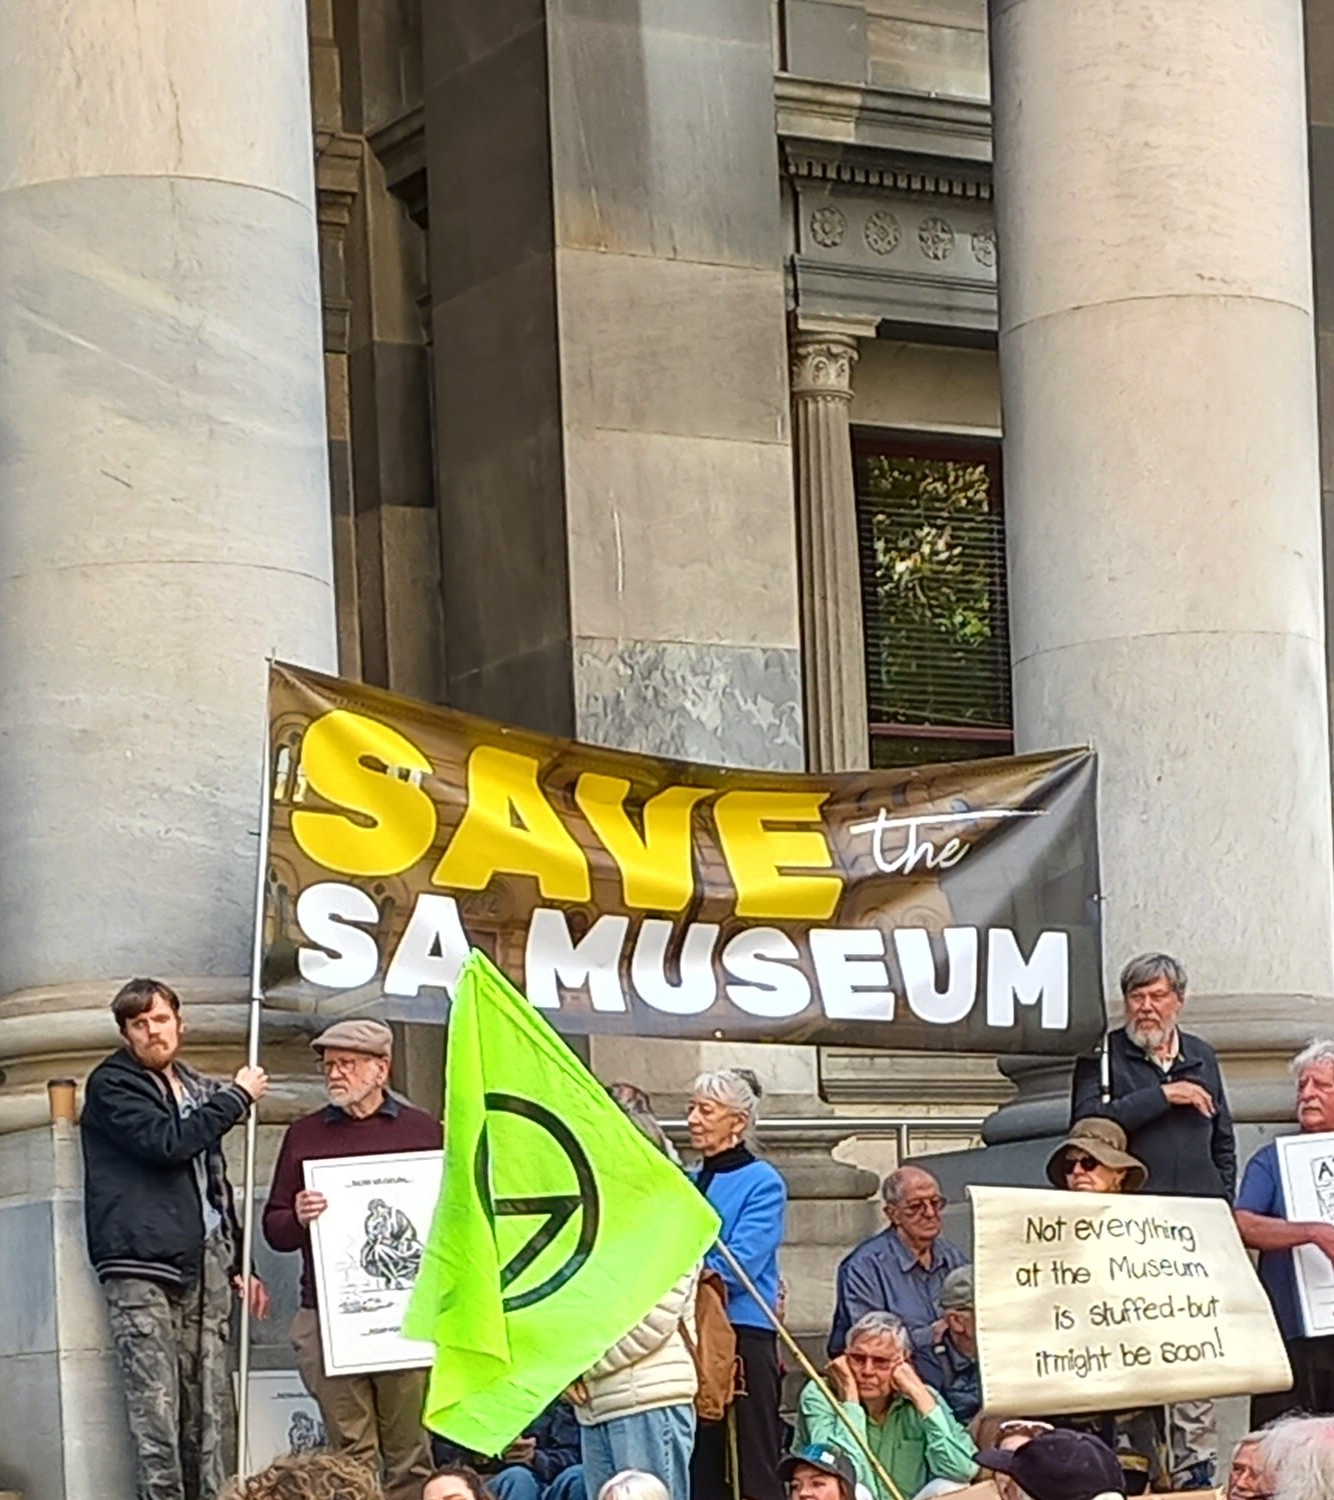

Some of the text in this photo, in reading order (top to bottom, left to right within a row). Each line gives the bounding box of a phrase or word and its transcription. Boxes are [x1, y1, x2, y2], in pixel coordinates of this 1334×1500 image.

[290, 708, 1049, 920] SAVE the
[295, 881, 1069, 1029] SA MUSEUM
[1026, 1217, 1196, 1251] Not everything
[1016, 1256, 1209, 1288] at the Museum
[1054, 1305, 1075, 1331] is
[1120, 1342, 1152, 1367] be
[1161, 1327, 1225, 1364] soon!
